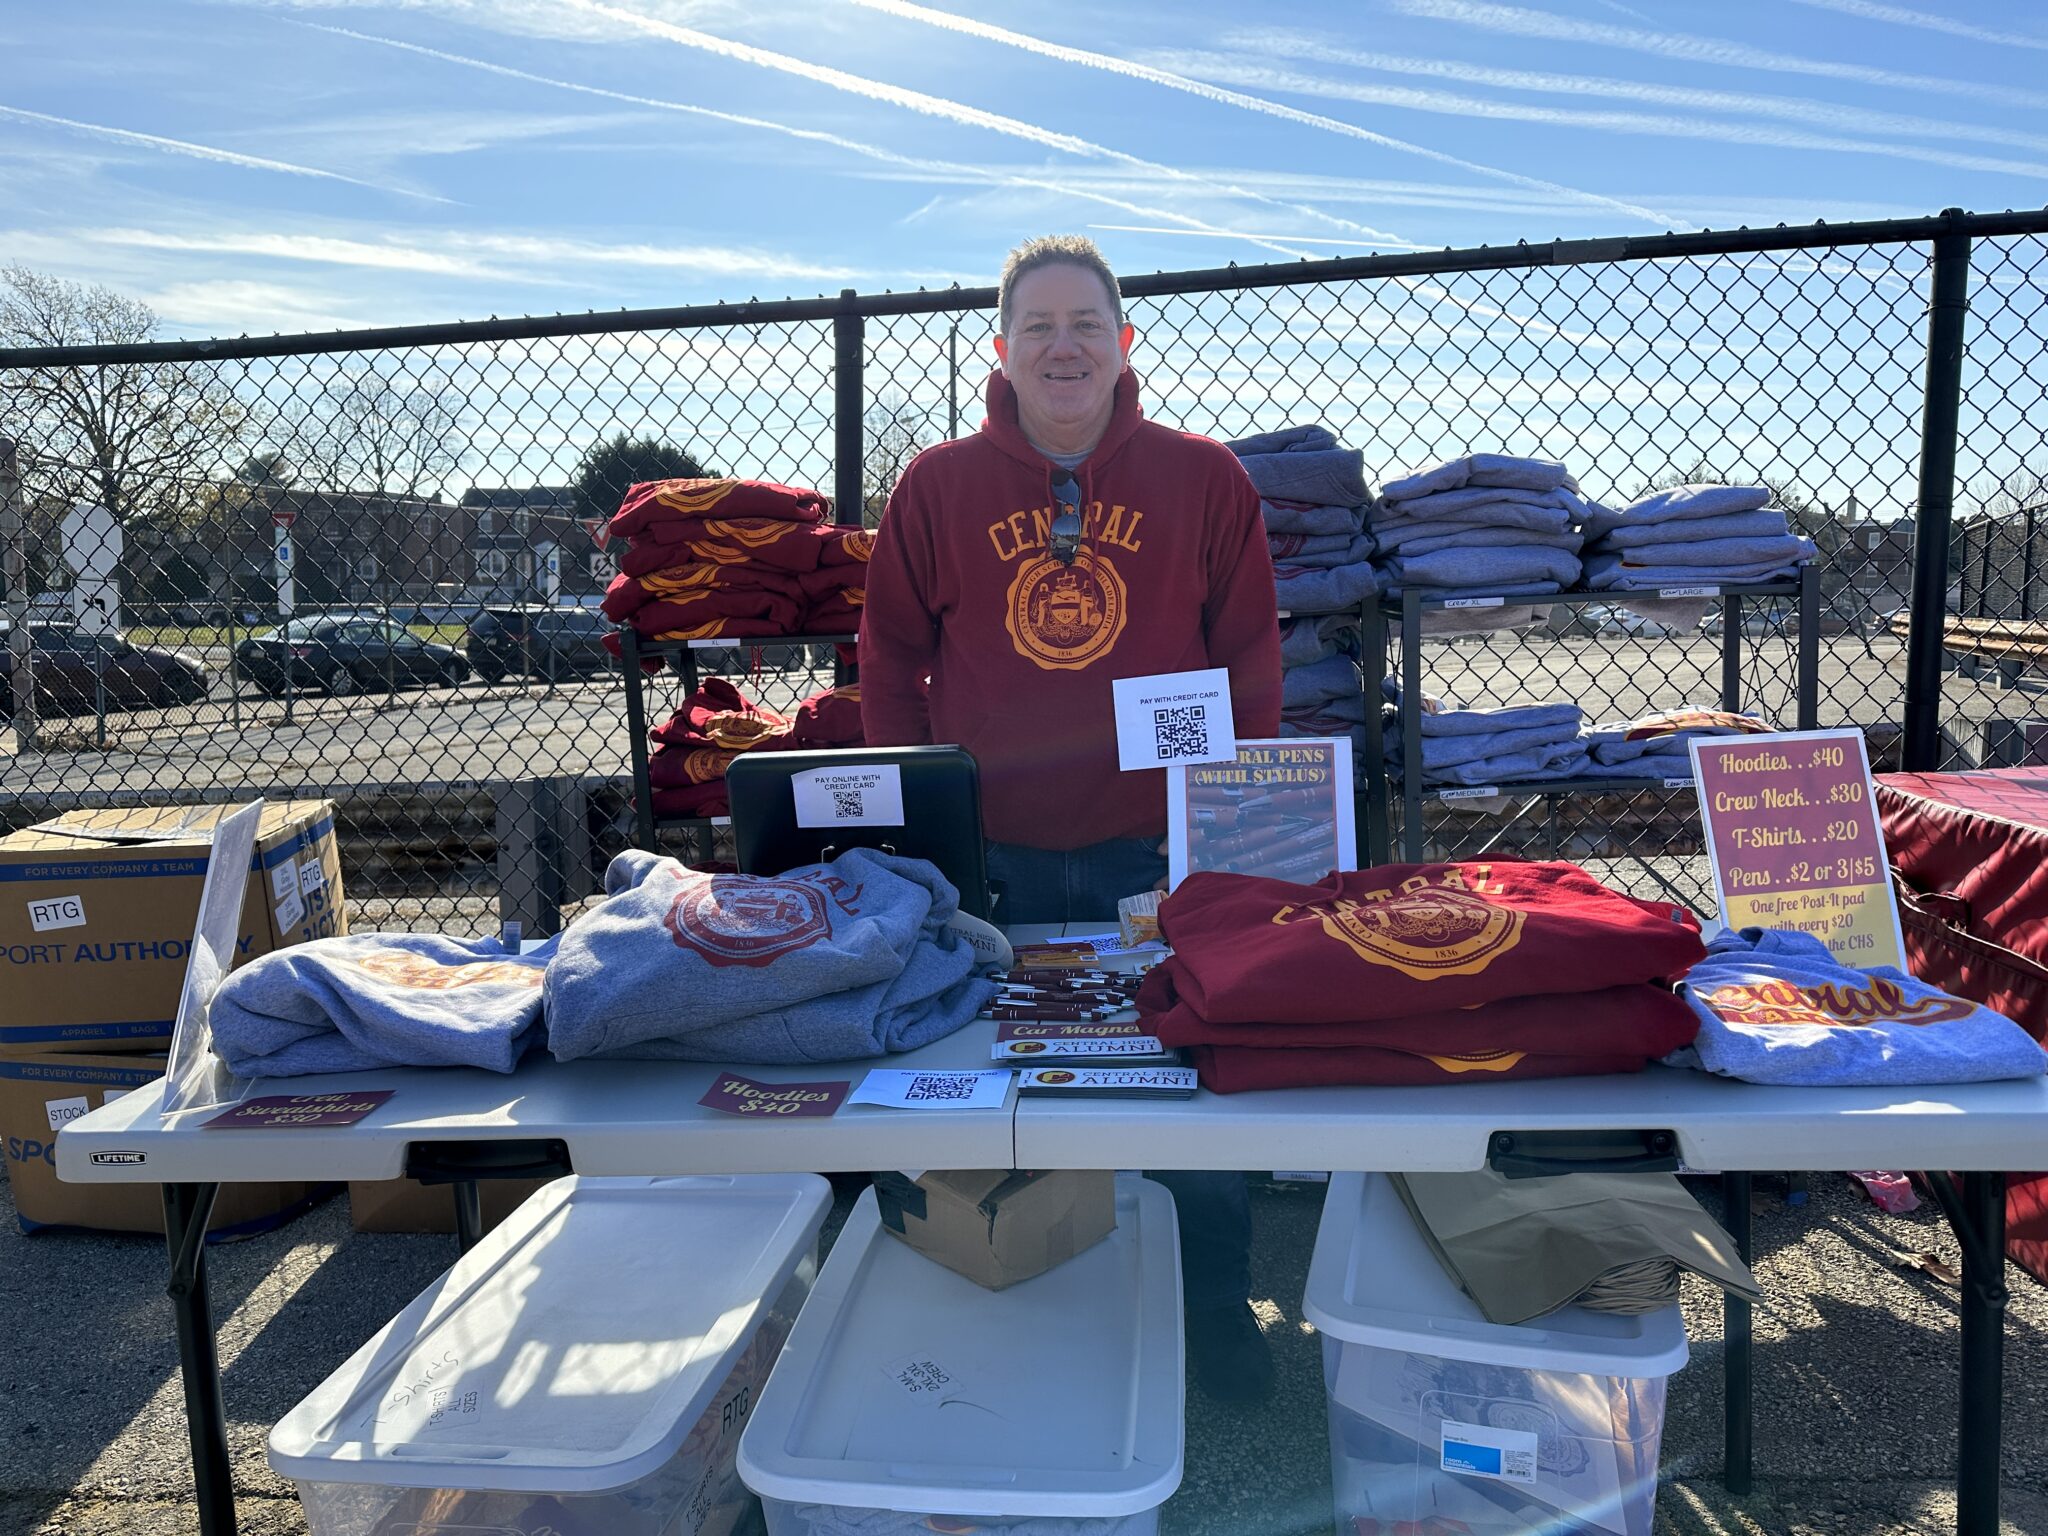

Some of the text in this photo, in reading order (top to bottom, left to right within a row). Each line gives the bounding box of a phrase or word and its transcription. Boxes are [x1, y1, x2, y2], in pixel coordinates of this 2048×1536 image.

[988, 501, 1143, 561] CENRAL
[1095, 570, 1115, 630] HILADELPHIA
[1154, 696, 1172, 704] WITH
[1172, 693, 1198, 702] CREDIT
[1199, 691, 1219, 699] CARD
[1279, 749, 1325, 764] PENS
[832, 775, 860, 783] ONLINE
[1194, 768, 1326, 785] (WITH STYLUS)
[853, 781, 876, 789] CARD
[1715, 792, 1758, 812] Crew
[25, 863, 194, 876] FOR EVERY COMPANY & TEAM
[302, 864, 320, 887] RTG
[1814, 865, 1832, 881] or
[1750, 891, 1865, 916] One free Post-It pad
[33, 902, 80, 923] RTG
[1798, 919, 1829, 934] every
[1832, 913, 1853, 928] $20
[976, 932, 997, 943] HIGH
[1828, 938, 1846, 952] the
[1848, 934, 1874, 949] CHS
[1434, 949, 1458, 959] 1836
[1710, 973, 1935, 1020] entral
[61, 1028, 106, 1036] APPAREL
[1013, 1026, 1053, 1036] Car
[1054, 1044, 1155, 1053] ALUMNI
[22, 1067, 41, 1076] FOR
[44, 1069, 73, 1078] EVERY
[76, 1071, 122, 1081] COMPANY
[1080, 1077, 1191, 1086] ALUMNI
[723, 1080, 830, 1102] Hoodies
[51, 1106, 86, 1121] STOCK
[235, 1102, 376, 1117] Sweatshirts
[738, 1098, 801, 1115] $40
[264, 1113, 322, 1125] $30
[97, 1154, 141, 1163] LIFETIME
[920, 1361, 950, 1384] CREW
[463, 1391, 478, 1413] SIZES
[722, 1387, 749, 1435] RTG
